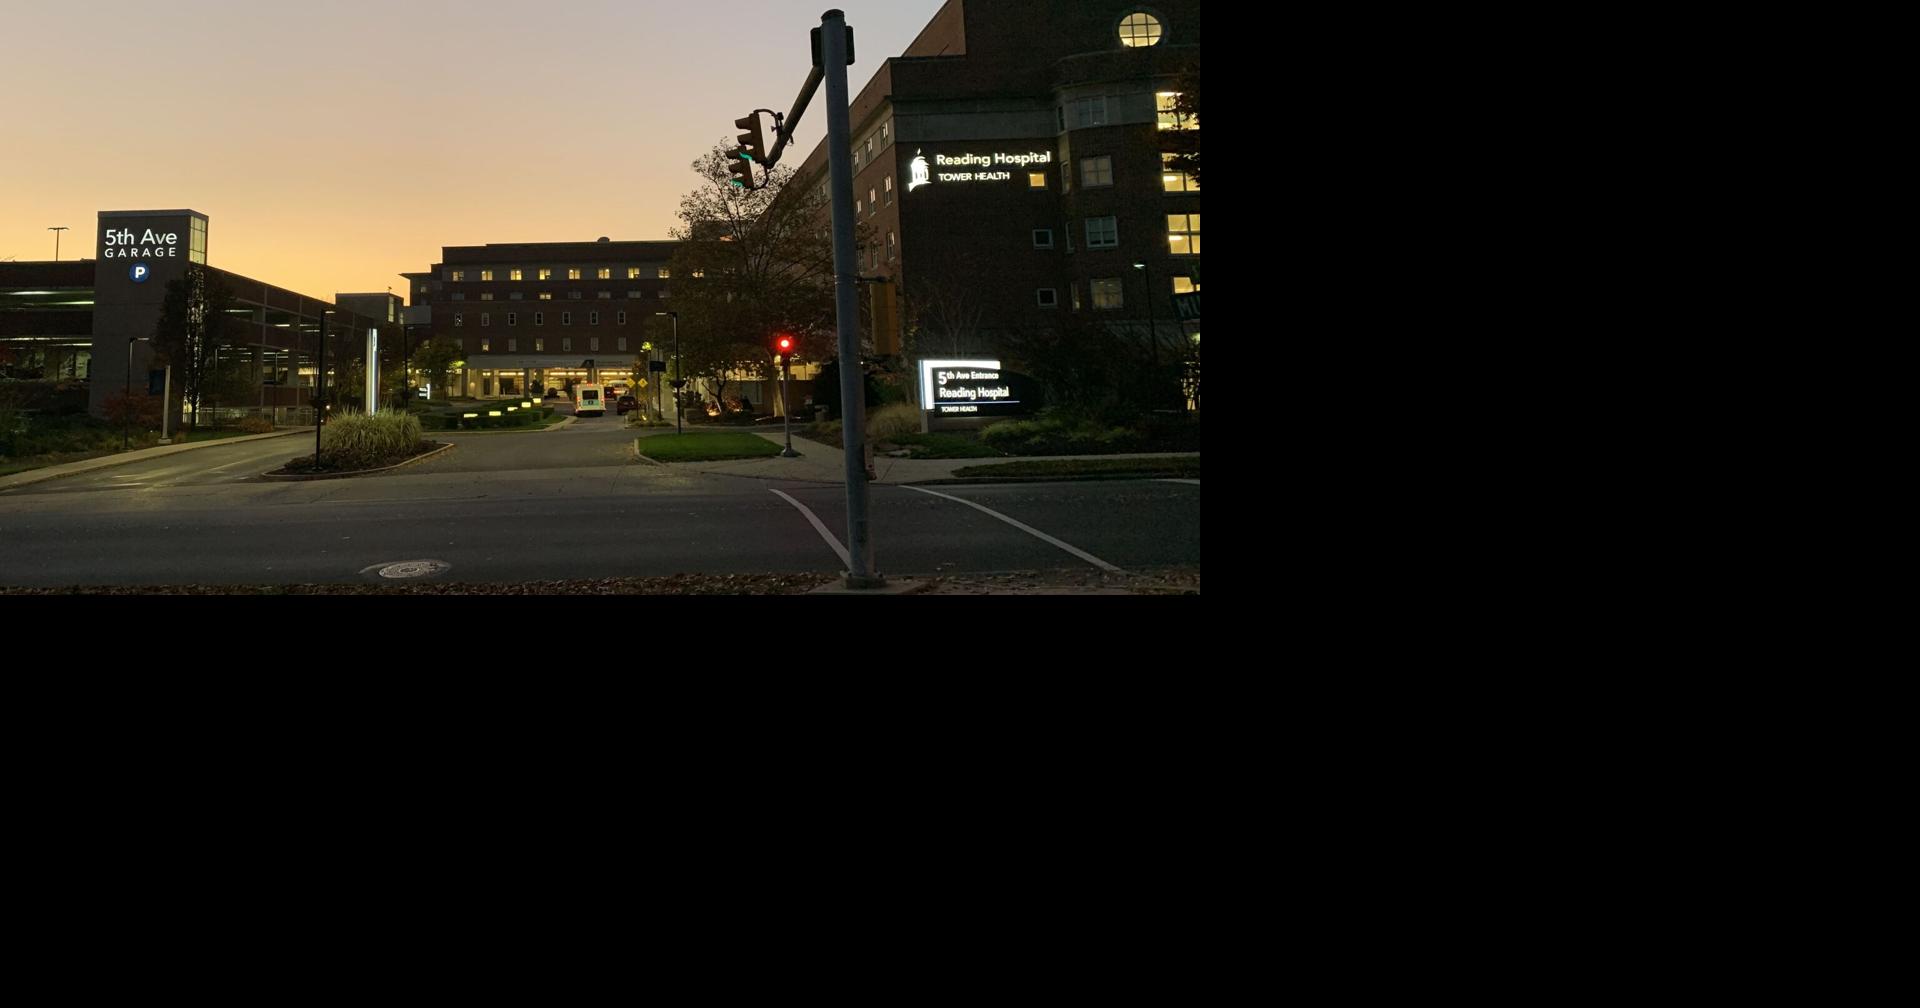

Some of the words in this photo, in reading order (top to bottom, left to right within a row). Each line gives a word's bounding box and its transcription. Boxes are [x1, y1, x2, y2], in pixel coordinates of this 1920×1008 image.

[936, 153, 991, 167] Reading
[994, 151, 1051, 167] Hospital
[938, 172, 972, 181] TOWER
[974, 171, 1010, 180] HEALTH
[105, 228, 134, 246] 5th
[140, 228, 178, 245] Ave
[104, 247, 176, 258] GARAGE
[135, 266, 146, 279] P
[938, 371, 955, 385] 5th
[956, 371, 970, 380] Ave
[971, 371, 999, 380] Entrance
[939, 386, 976, 400] Reading
[977, 385, 1009, 400] Hospital
